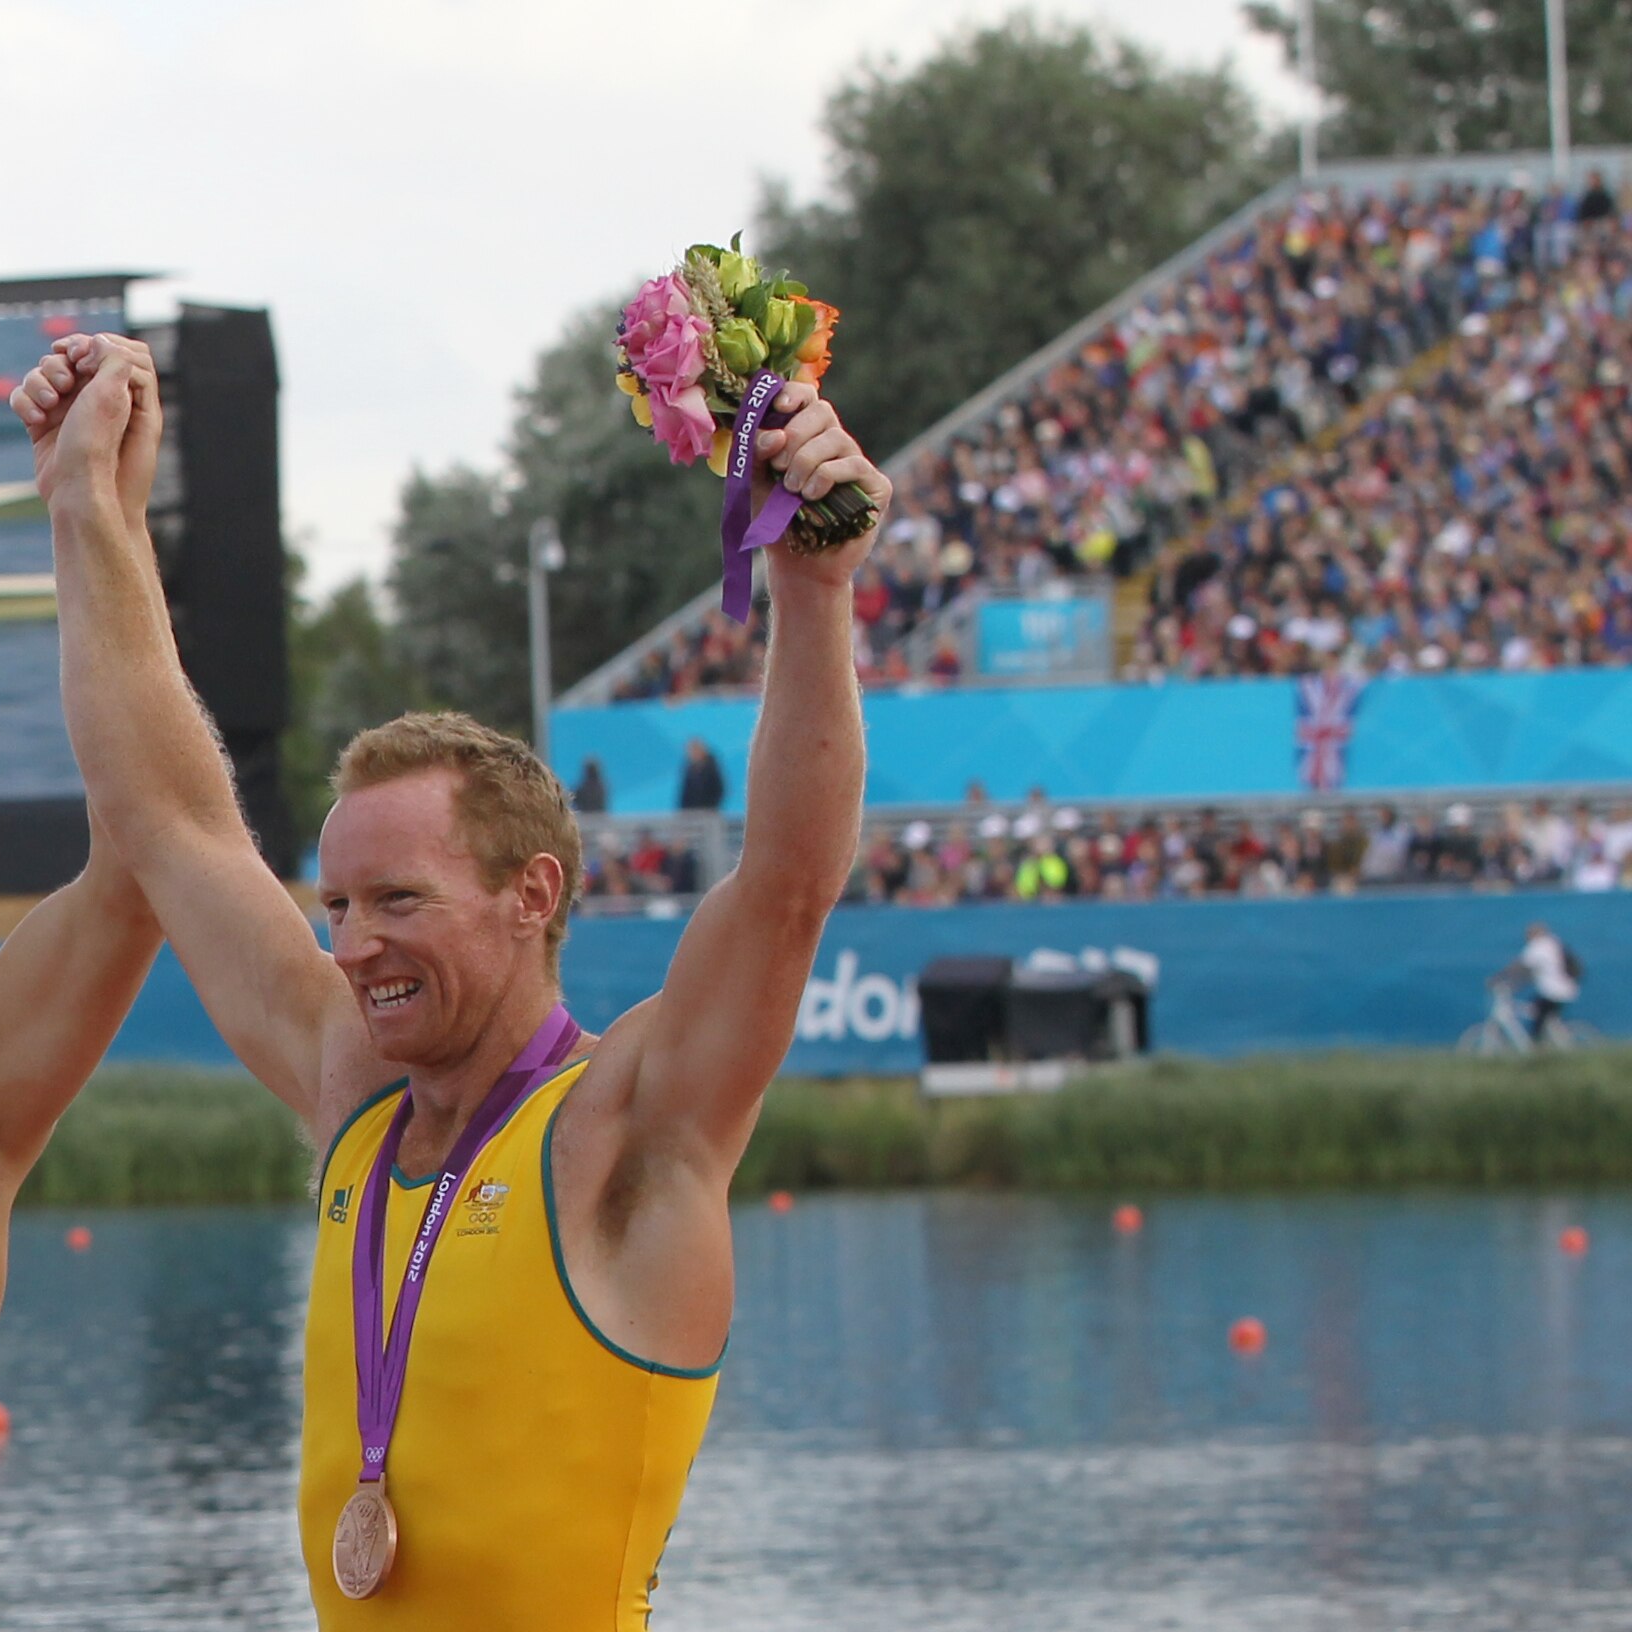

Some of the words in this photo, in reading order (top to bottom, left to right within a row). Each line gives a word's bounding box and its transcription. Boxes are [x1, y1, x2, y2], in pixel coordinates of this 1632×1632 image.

[732, 410, 757, 479] London
[747, 373, 778, 409] 2012
[421, 1171, 457, 1236] London
[407, 1239, 429, 1282] 2012
